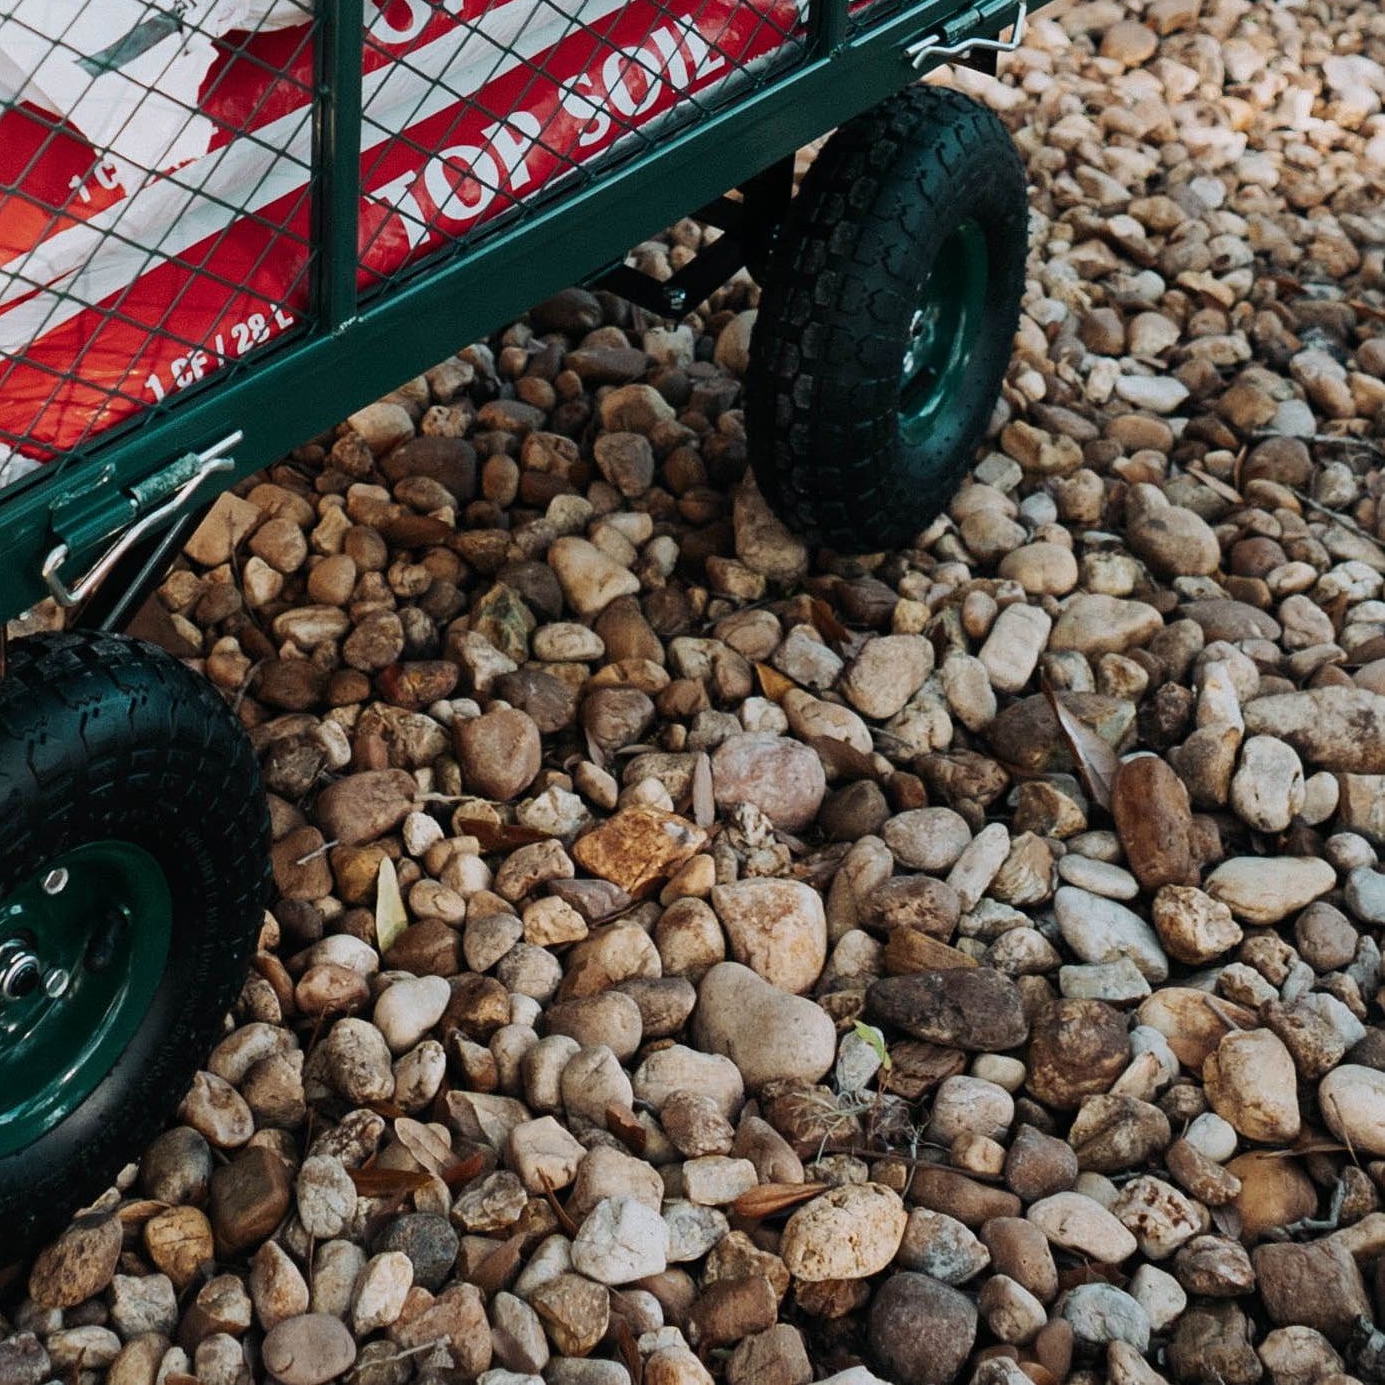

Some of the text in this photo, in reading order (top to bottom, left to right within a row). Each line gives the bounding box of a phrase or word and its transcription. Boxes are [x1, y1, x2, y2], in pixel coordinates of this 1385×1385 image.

[366, 13, 725, 251] TOP SOIL
[144, 373, 165, 402] 1
[171, 349, 209, 389] CF
[231, 313, 270, 355] 28
